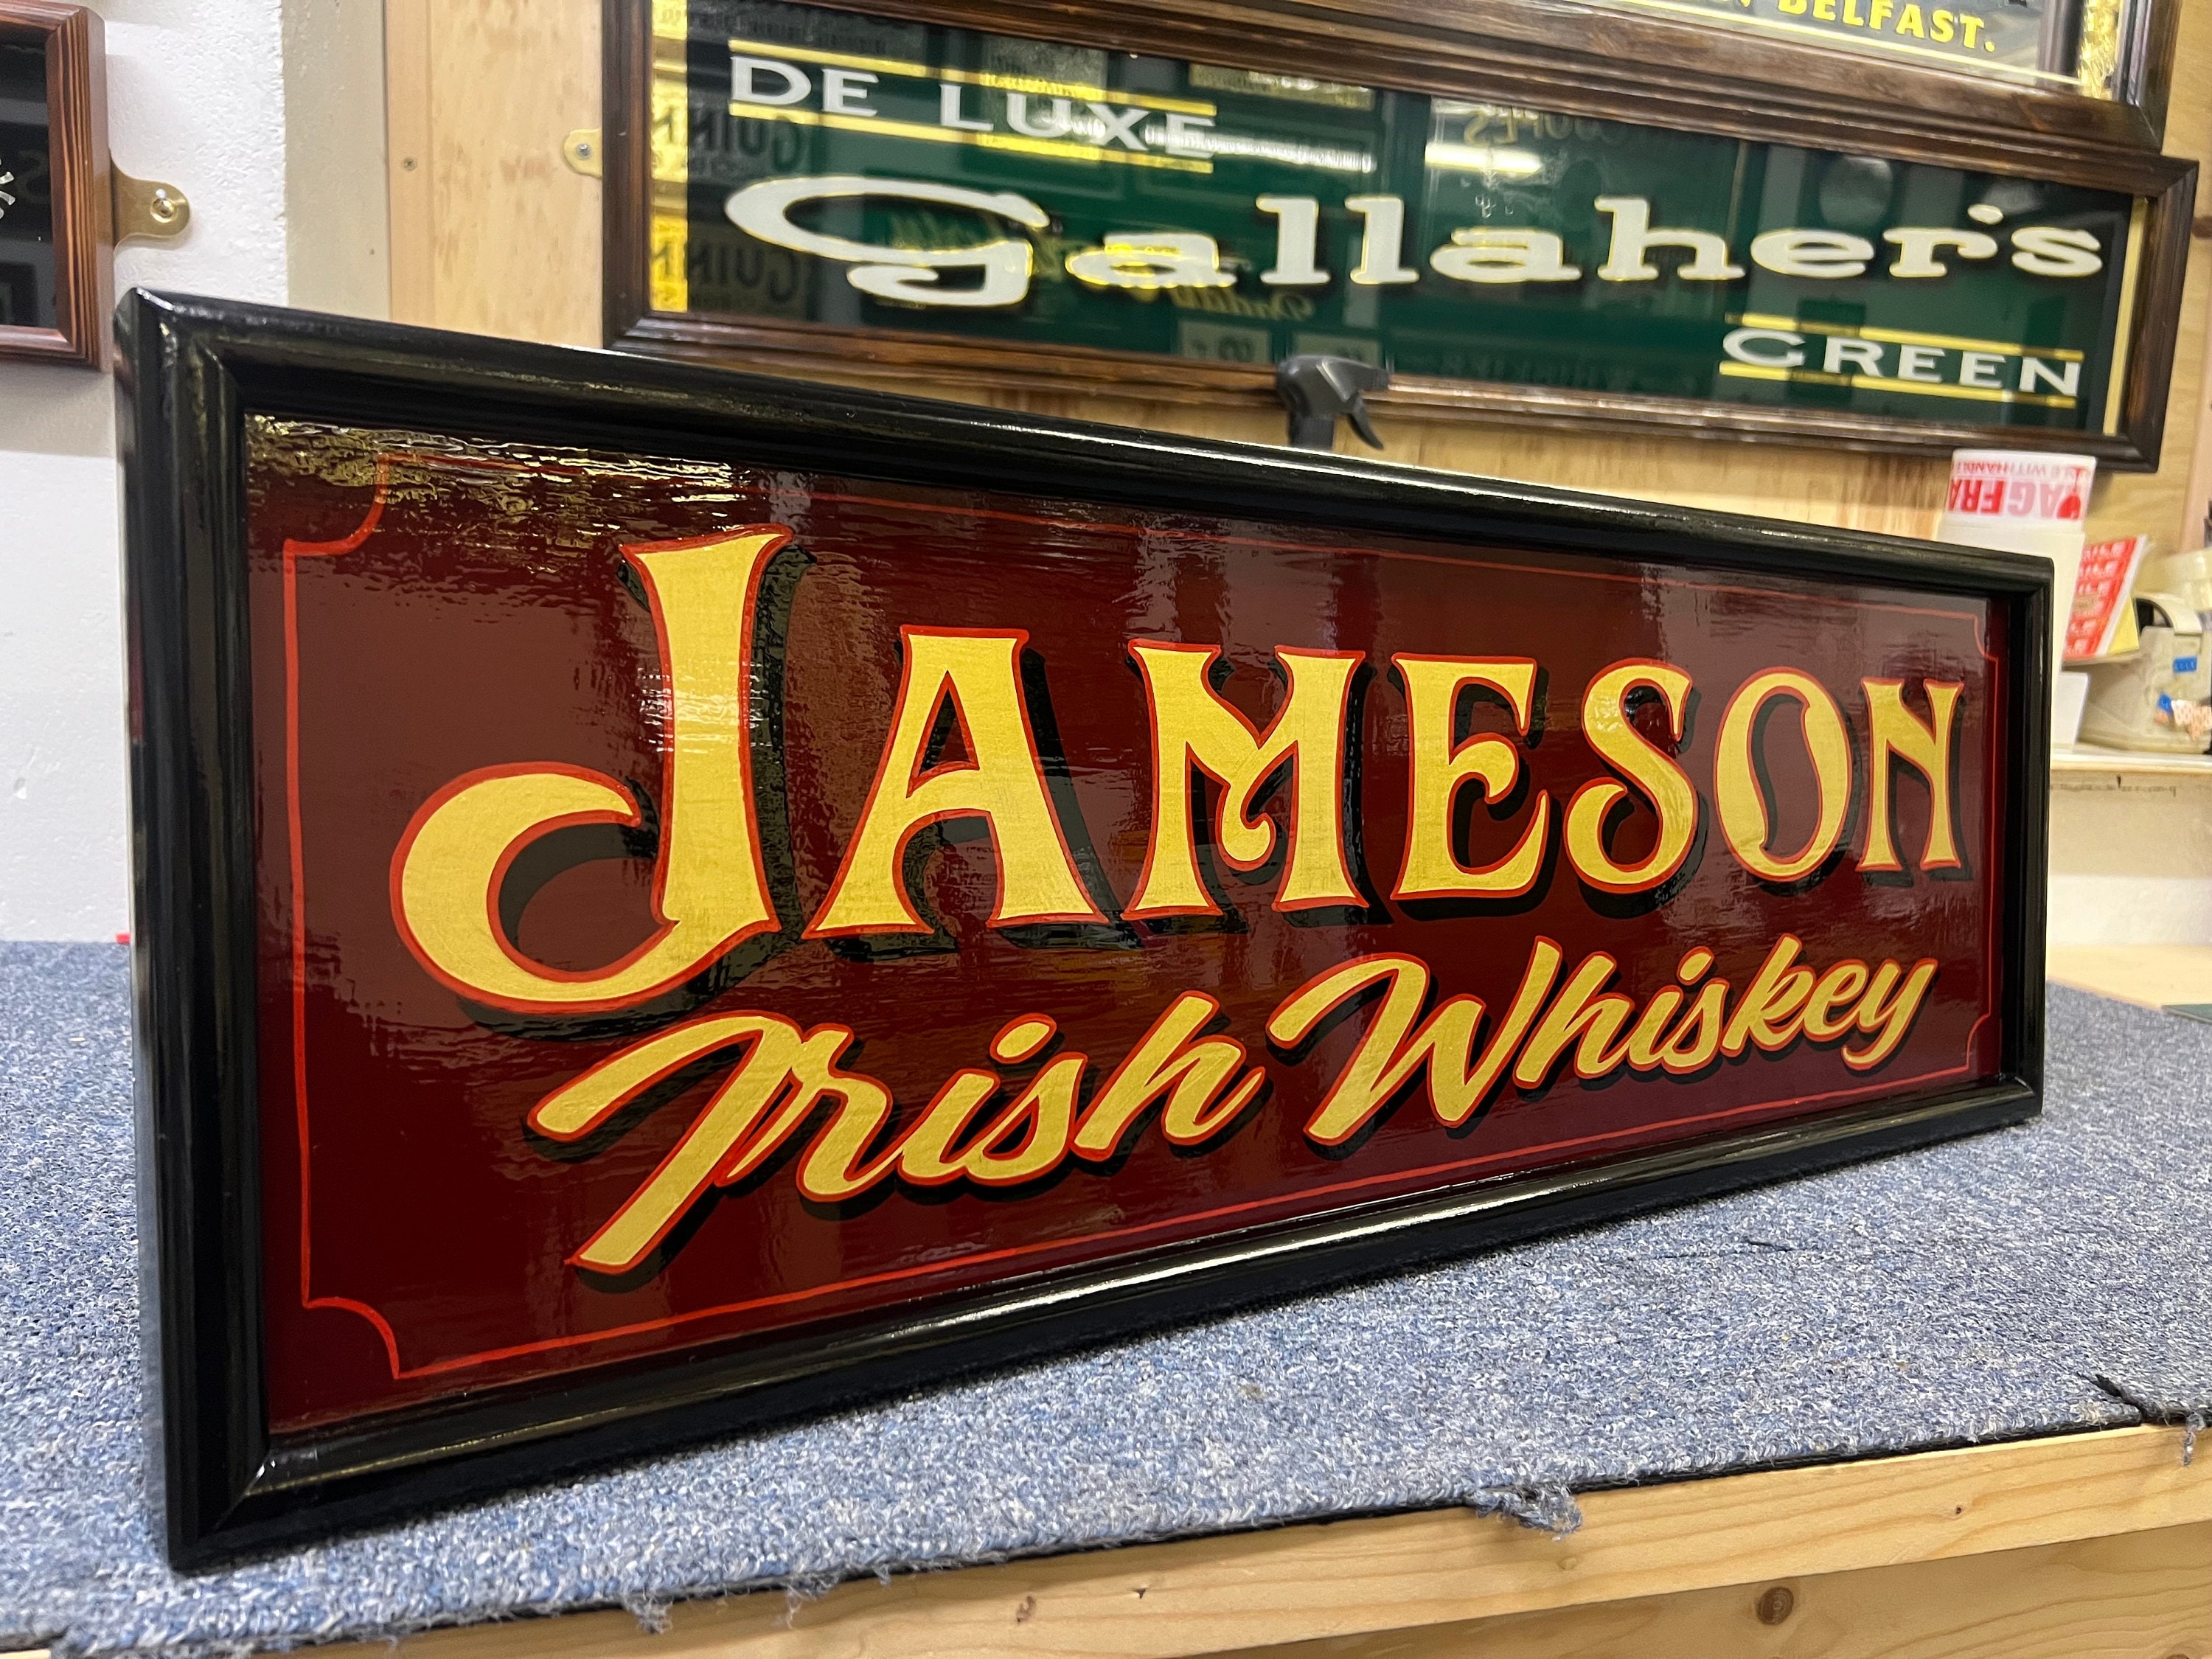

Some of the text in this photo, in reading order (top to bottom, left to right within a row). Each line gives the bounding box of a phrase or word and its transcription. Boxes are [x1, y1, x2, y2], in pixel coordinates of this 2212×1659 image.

[729, 56, 880, 117] DE
[939, 83, 1217, 160] LUXE
[724, 175, 2104, 307] Gallaher's
[1722, 327, 2082, 398] GREEN
[390, 524, 1964, 1014] JAMESON
[527, 933, 1938, 1274] Irish Whiskey
